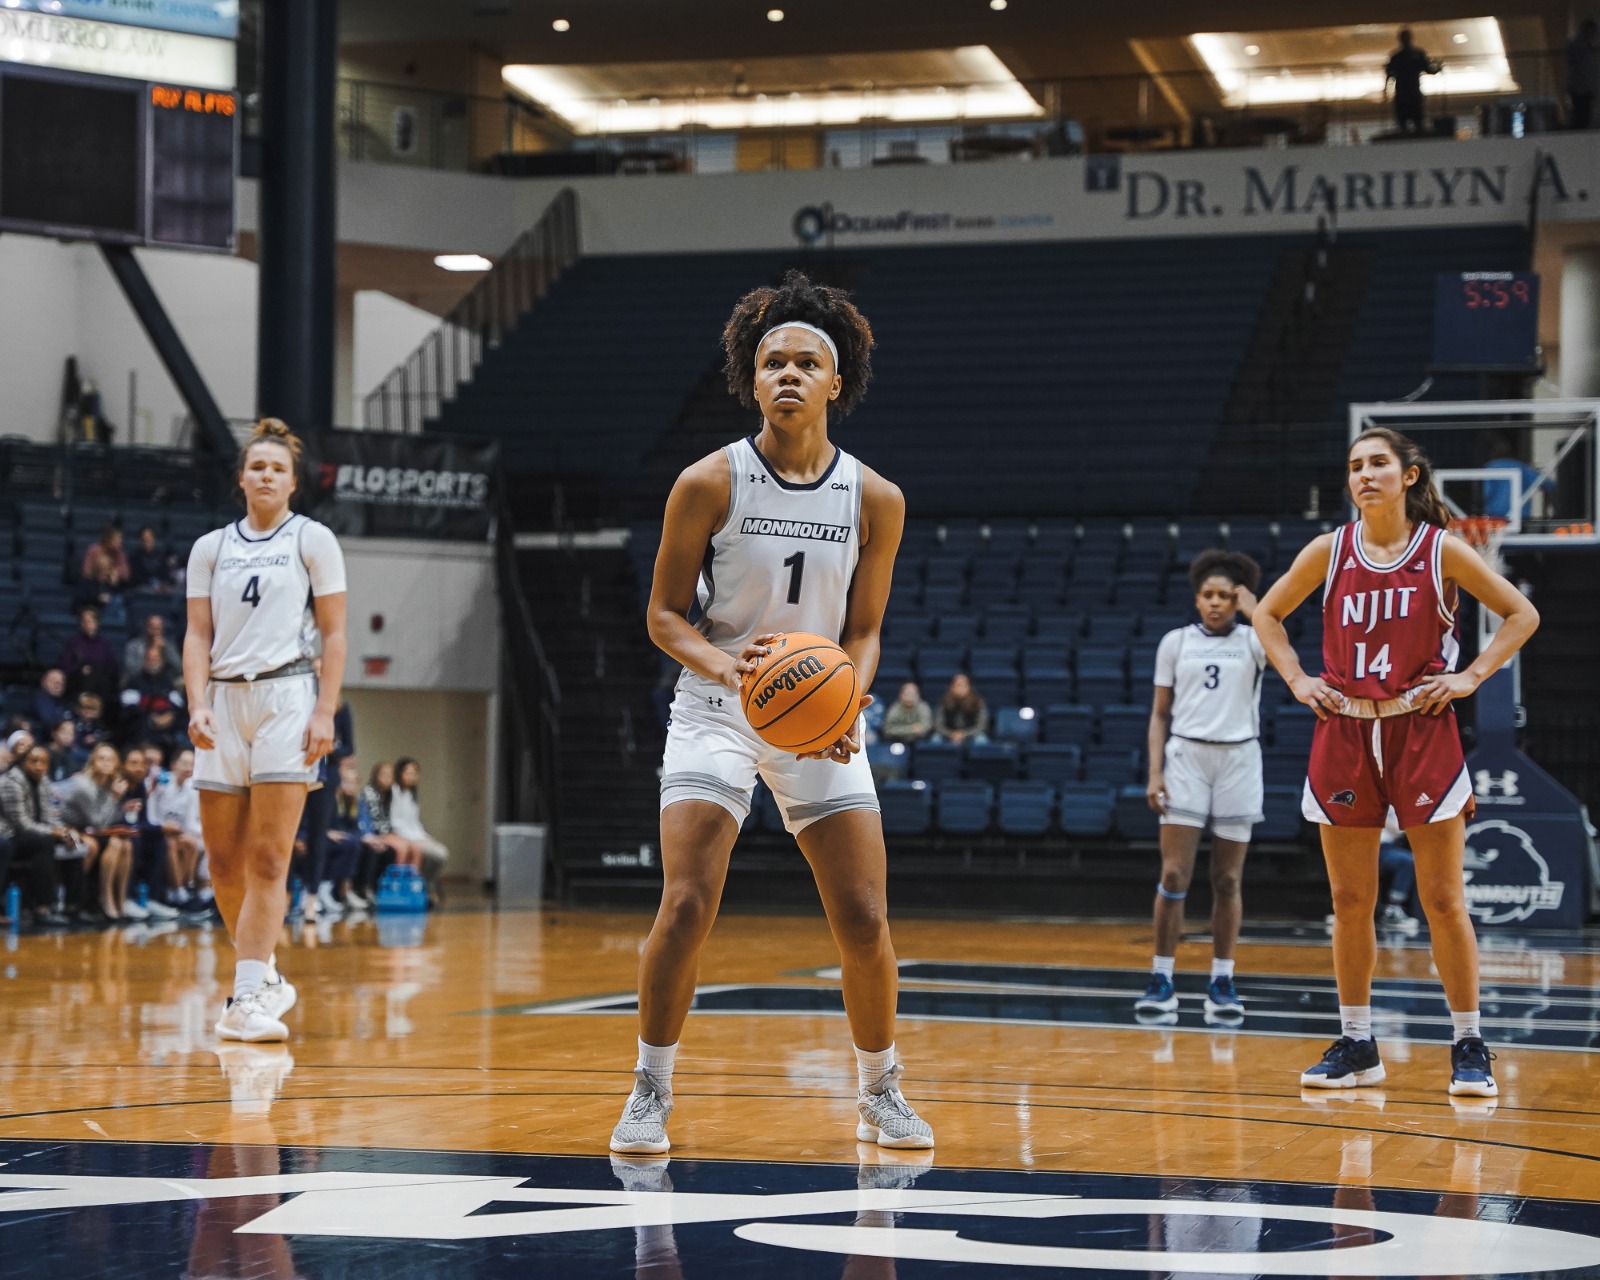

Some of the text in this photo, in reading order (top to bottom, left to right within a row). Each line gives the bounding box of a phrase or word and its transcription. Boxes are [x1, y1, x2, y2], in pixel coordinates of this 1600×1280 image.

[1243, 163, 1508, 217] MARILYN
[831, 482, 849, 492] CAA
[741, 518, 850, 543] MONMOUTH
[241, 575, 261, 607] 4
[783, 550, 805, 605] 1
[1342, 587, 1417, 634] NJIT
[1204, 664, 1220, 690] 3
[1354, 642, 1392, 681] 14
[752, 655, 826, 710] Wilson
